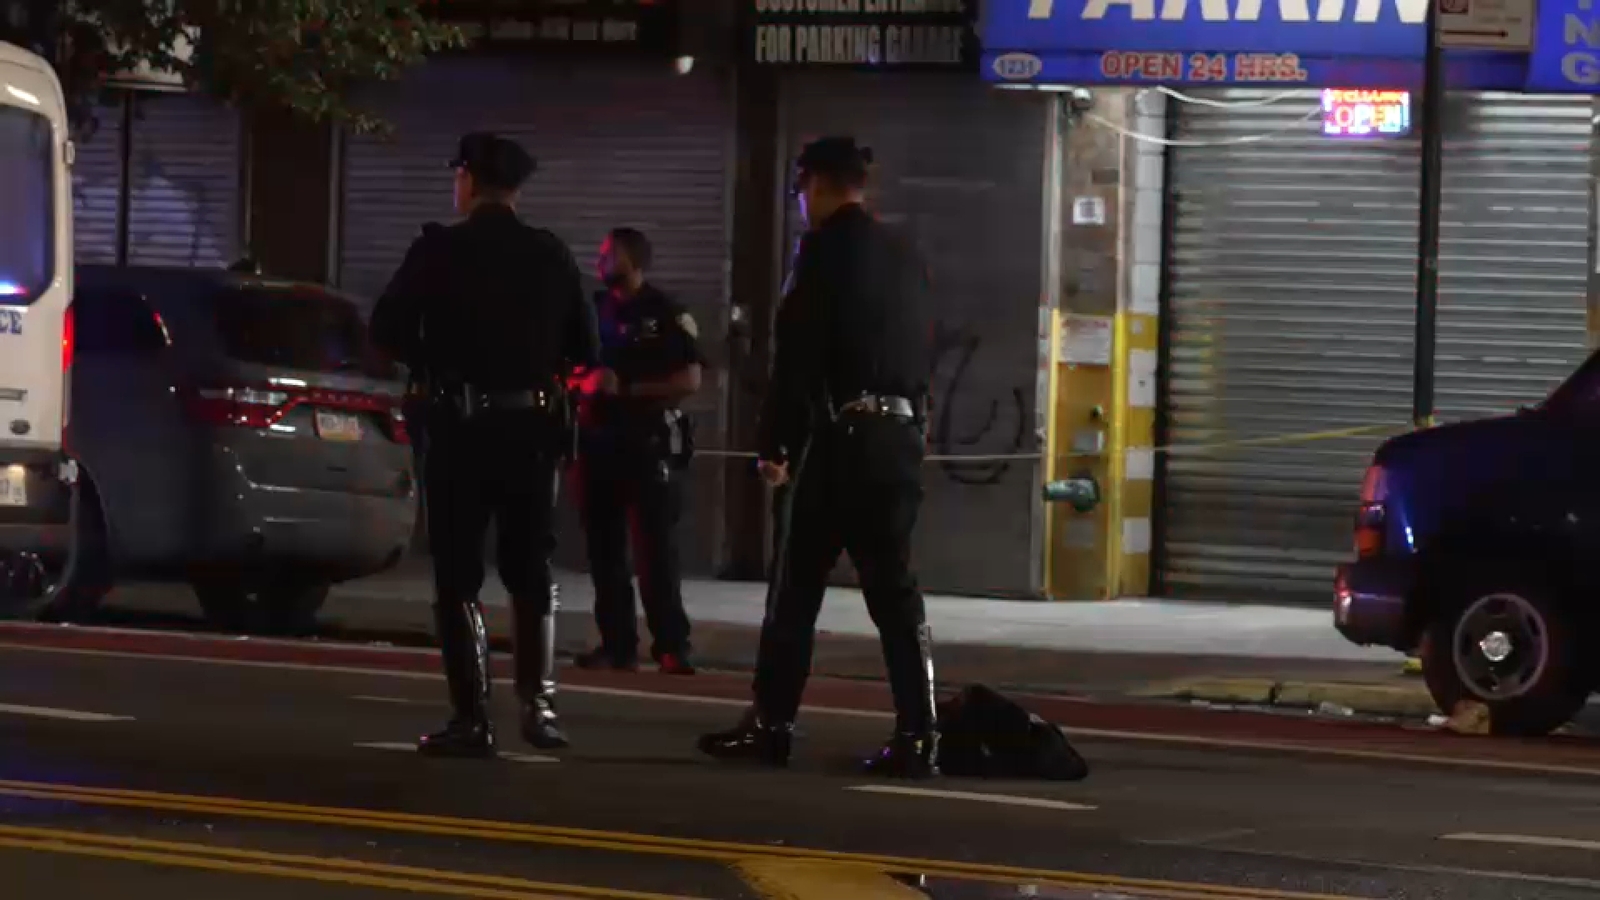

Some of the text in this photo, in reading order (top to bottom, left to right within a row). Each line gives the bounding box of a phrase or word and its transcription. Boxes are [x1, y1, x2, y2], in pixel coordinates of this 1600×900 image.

[755, 25, 791, 63] FOR
[795, 25, 881, 63] PARKING
[1102, 51, 1307, 82] OPEN 24 HRS.
[1335, 104, 1401, 127] OPEN
